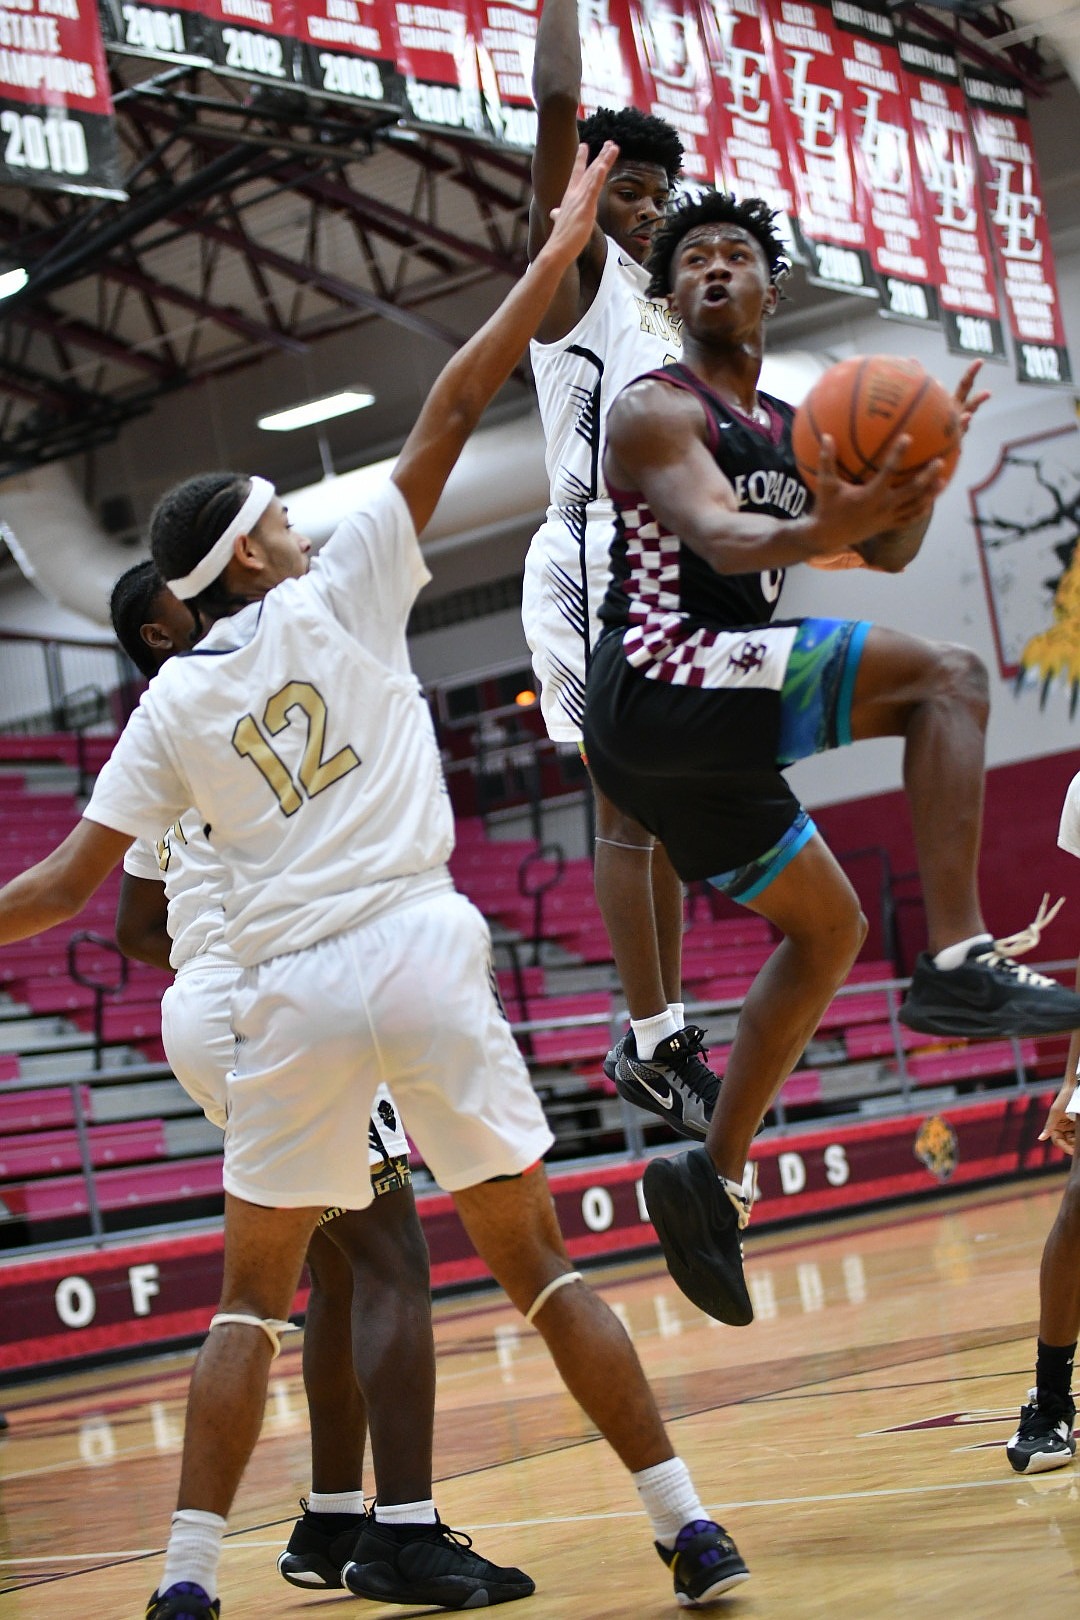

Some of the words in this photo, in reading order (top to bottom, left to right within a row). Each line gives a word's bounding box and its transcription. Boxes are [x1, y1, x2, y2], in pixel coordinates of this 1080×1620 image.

[122, 4, 186, 52] 2001
[221, 27, 287, 78] 2002
[318, 52, 384, 100] 2003
[1, 110, 89, 175] 2010
[231, 680, 361, 818] 12
[54, 1263, 160, 1329] OF
